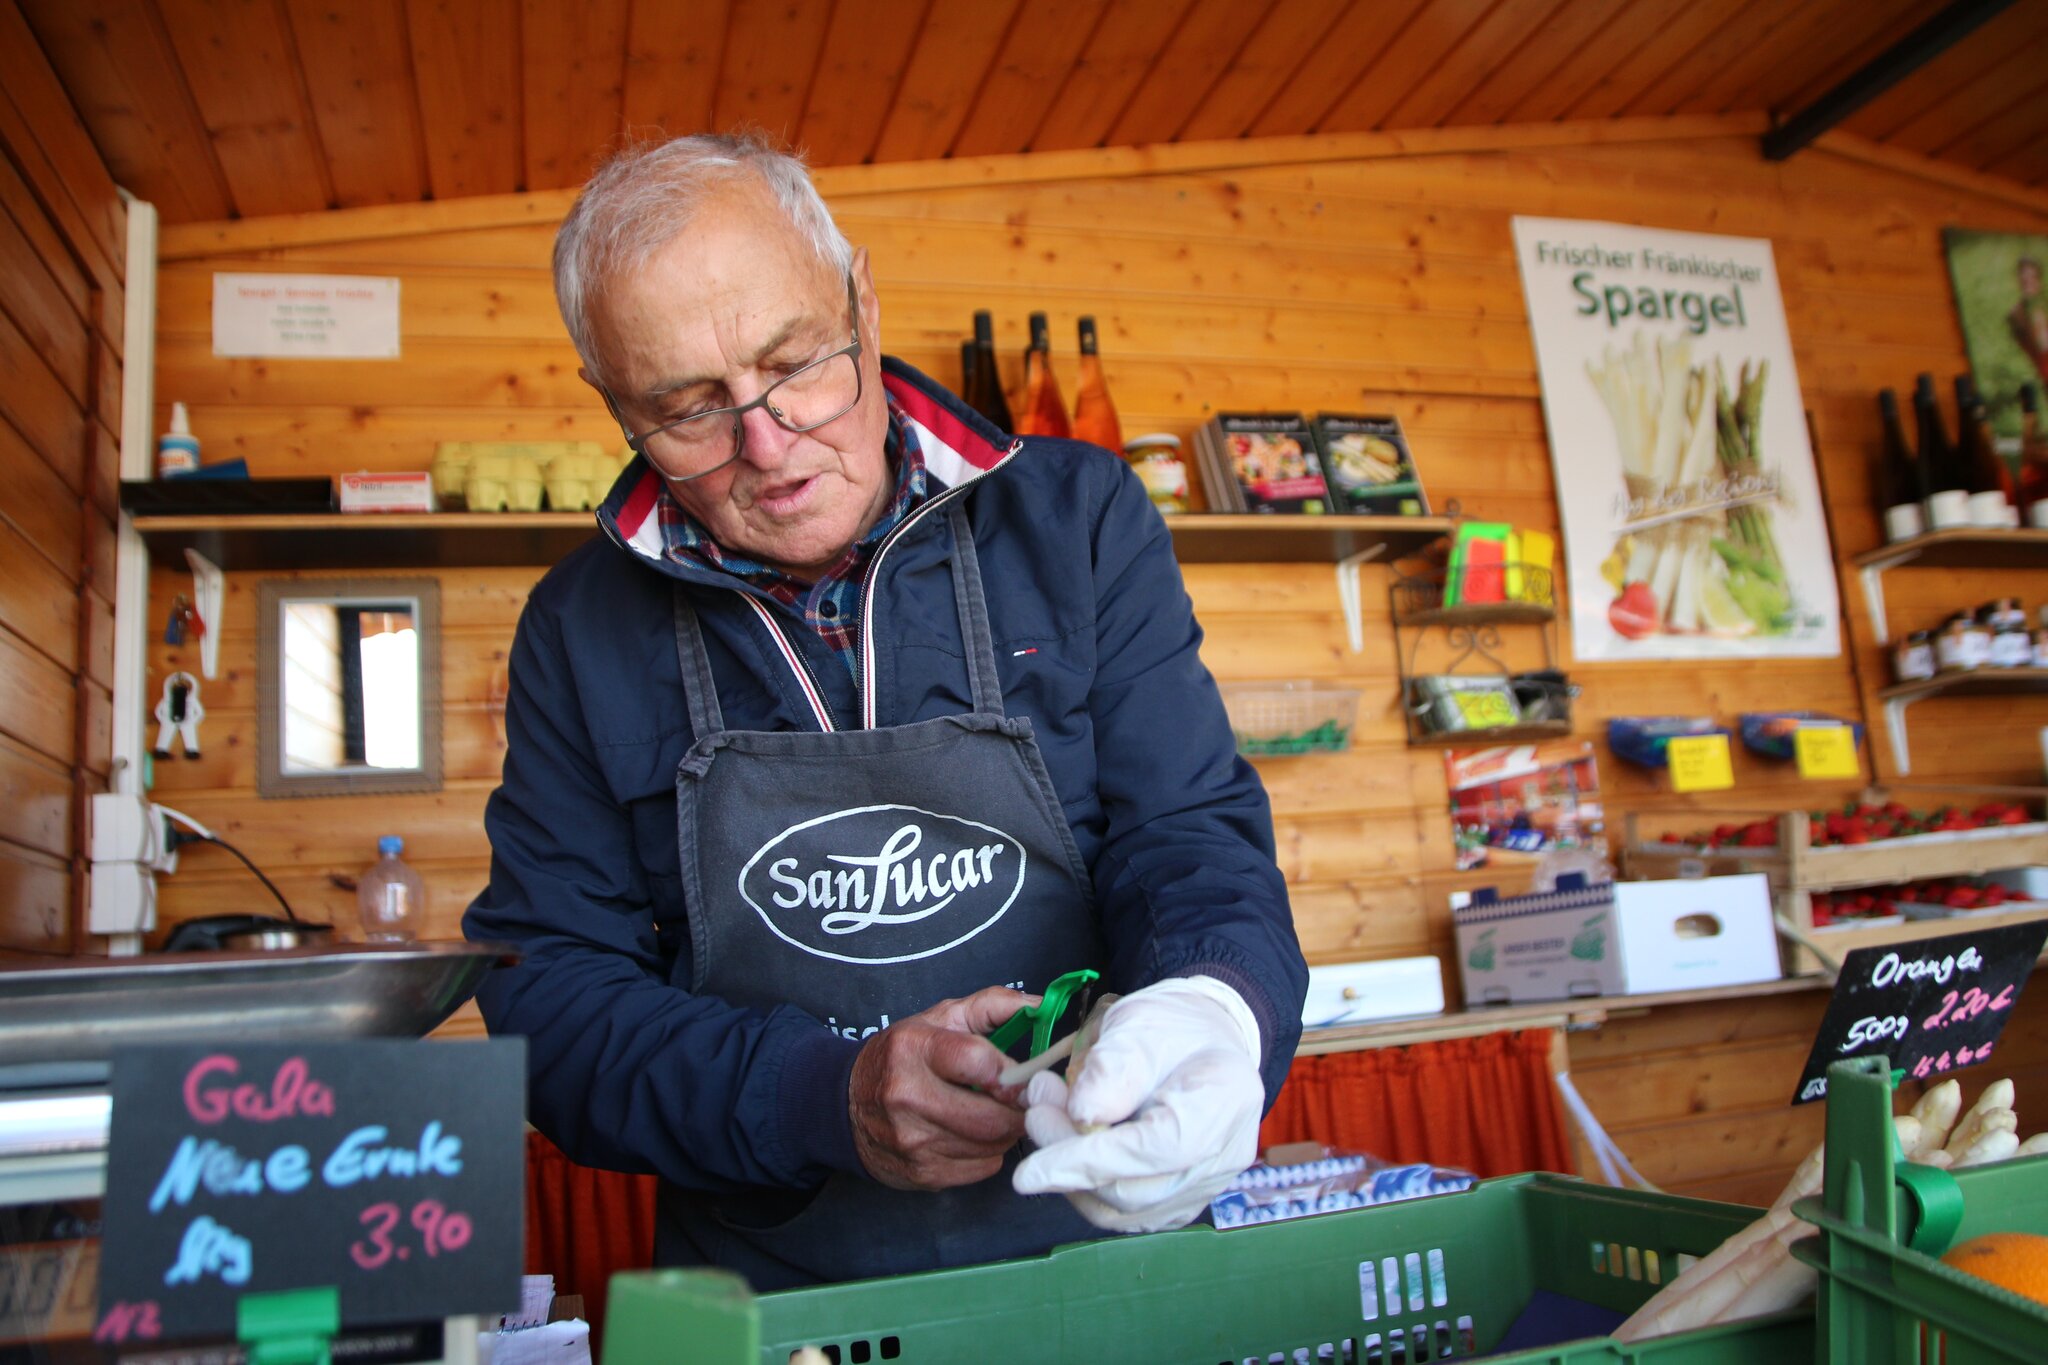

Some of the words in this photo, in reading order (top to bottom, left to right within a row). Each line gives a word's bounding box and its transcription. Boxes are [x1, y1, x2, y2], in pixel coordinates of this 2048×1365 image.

[1536, 241, 1635, 269] Frischer
[1642, 246, 1763, 283] Fränkischer
[1572, 270, 1747, 335] Spargel
[768, 824, 1004, 935] SanLucar
[1871, 946, 1984, 988] Orangen
[1841, 1014, 1910, 1052] 500g
[183, 1053, 336, 1124] Gala
[148, 1134, 313, 1215] Neue
[349, 1199, 475, 1270] 3.90
